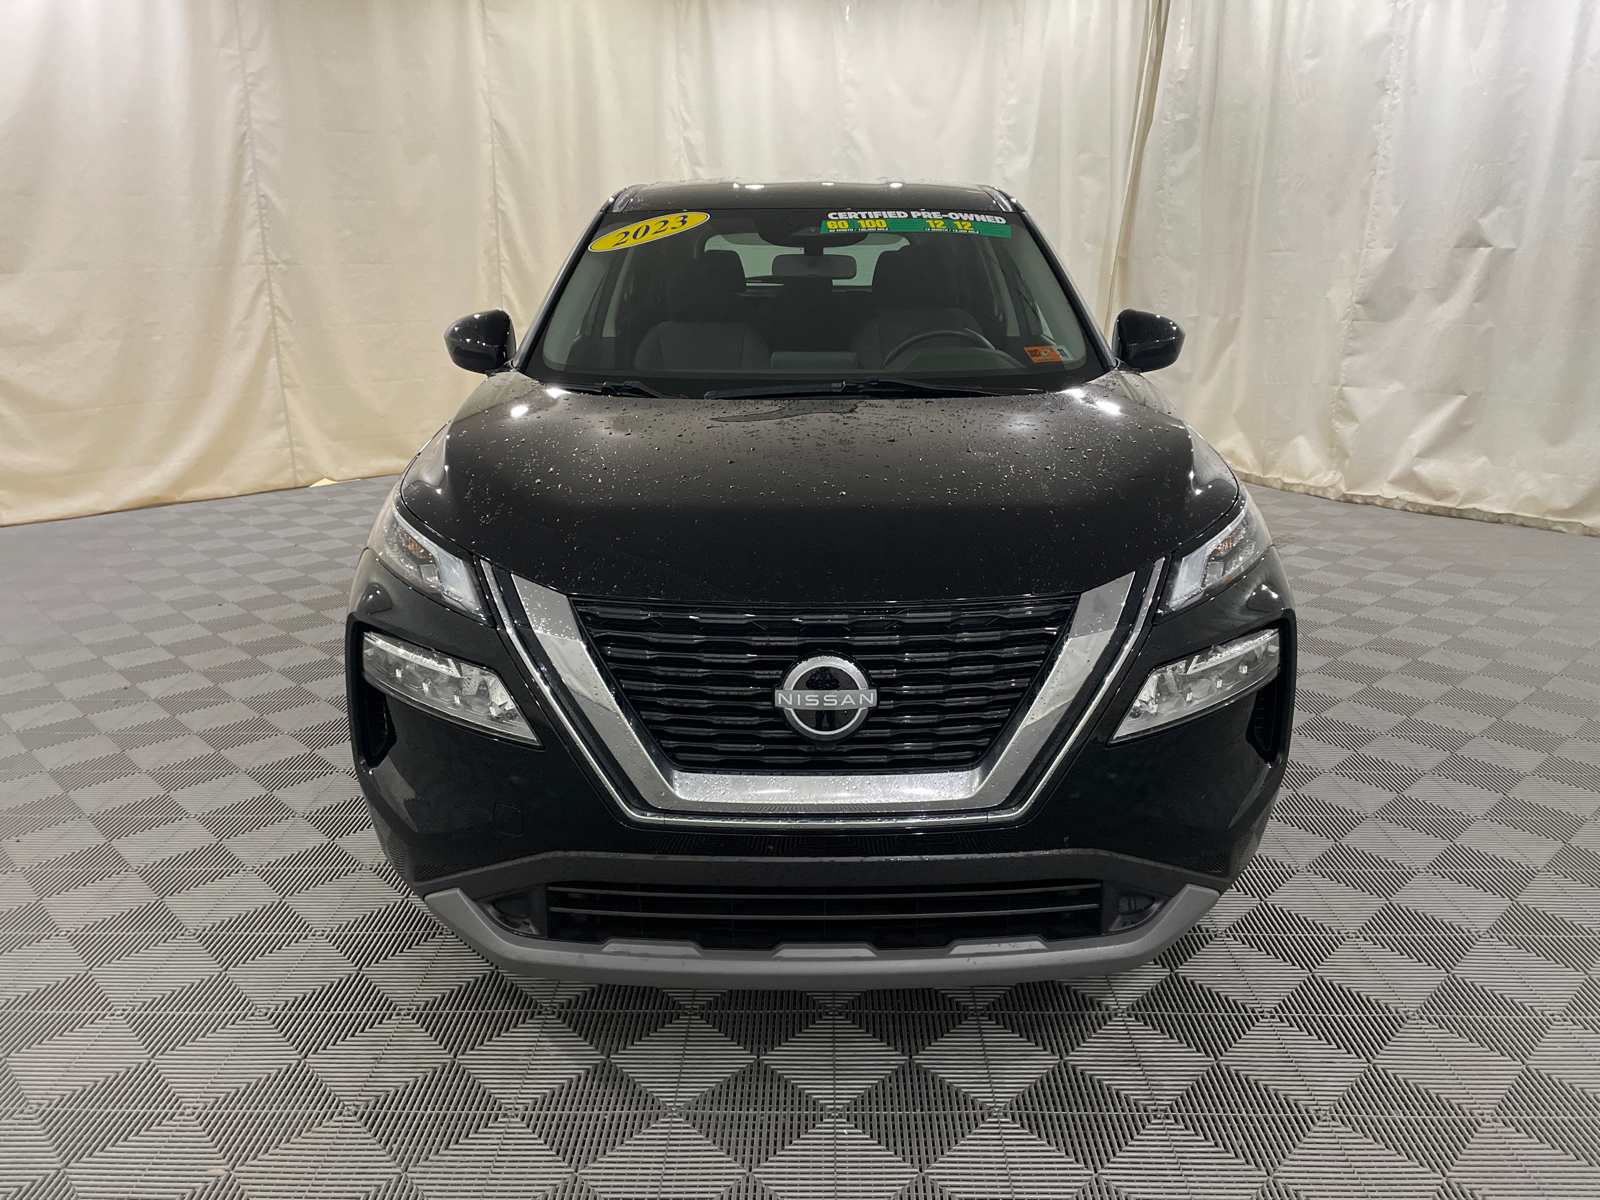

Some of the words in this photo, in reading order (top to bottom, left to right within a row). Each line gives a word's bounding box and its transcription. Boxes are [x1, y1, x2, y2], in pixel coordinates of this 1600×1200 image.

[827, 211, 908, 219] CERTIFIED
[911, 211, 1007, 224] PRE-OWNED
[857, 219, 887, 228] 100
[612, 214, 689, 247] 2023
[925, 219, 947, 229] 12
[953, 221, 974, 231] 12
[778, 692, 874, 706] NISSAN
